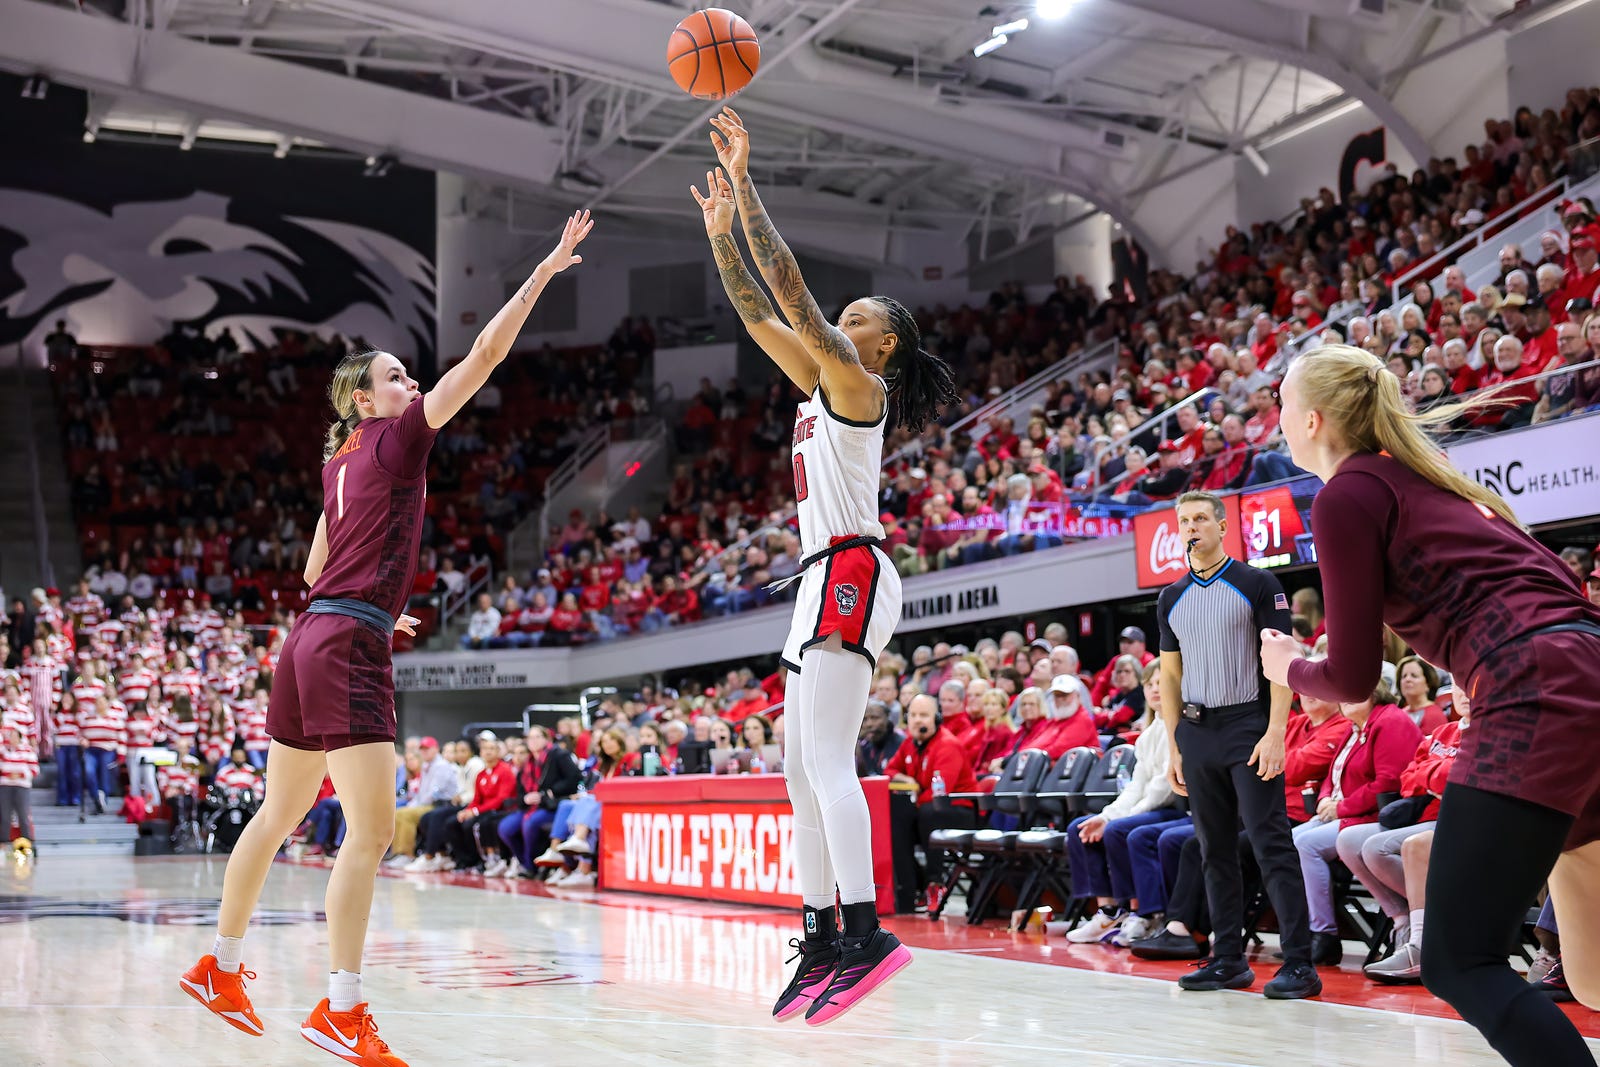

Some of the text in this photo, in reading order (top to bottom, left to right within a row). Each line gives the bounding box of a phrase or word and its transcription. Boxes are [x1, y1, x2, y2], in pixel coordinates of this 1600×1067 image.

[793, 416, 818, 447] TATE
[336, 463, 348, 521] 1
[1252, 508, 1282, 552] 51
[957, 585, 999, 611] ARENA
[622, 812, 803, 895] WOLFPACK
